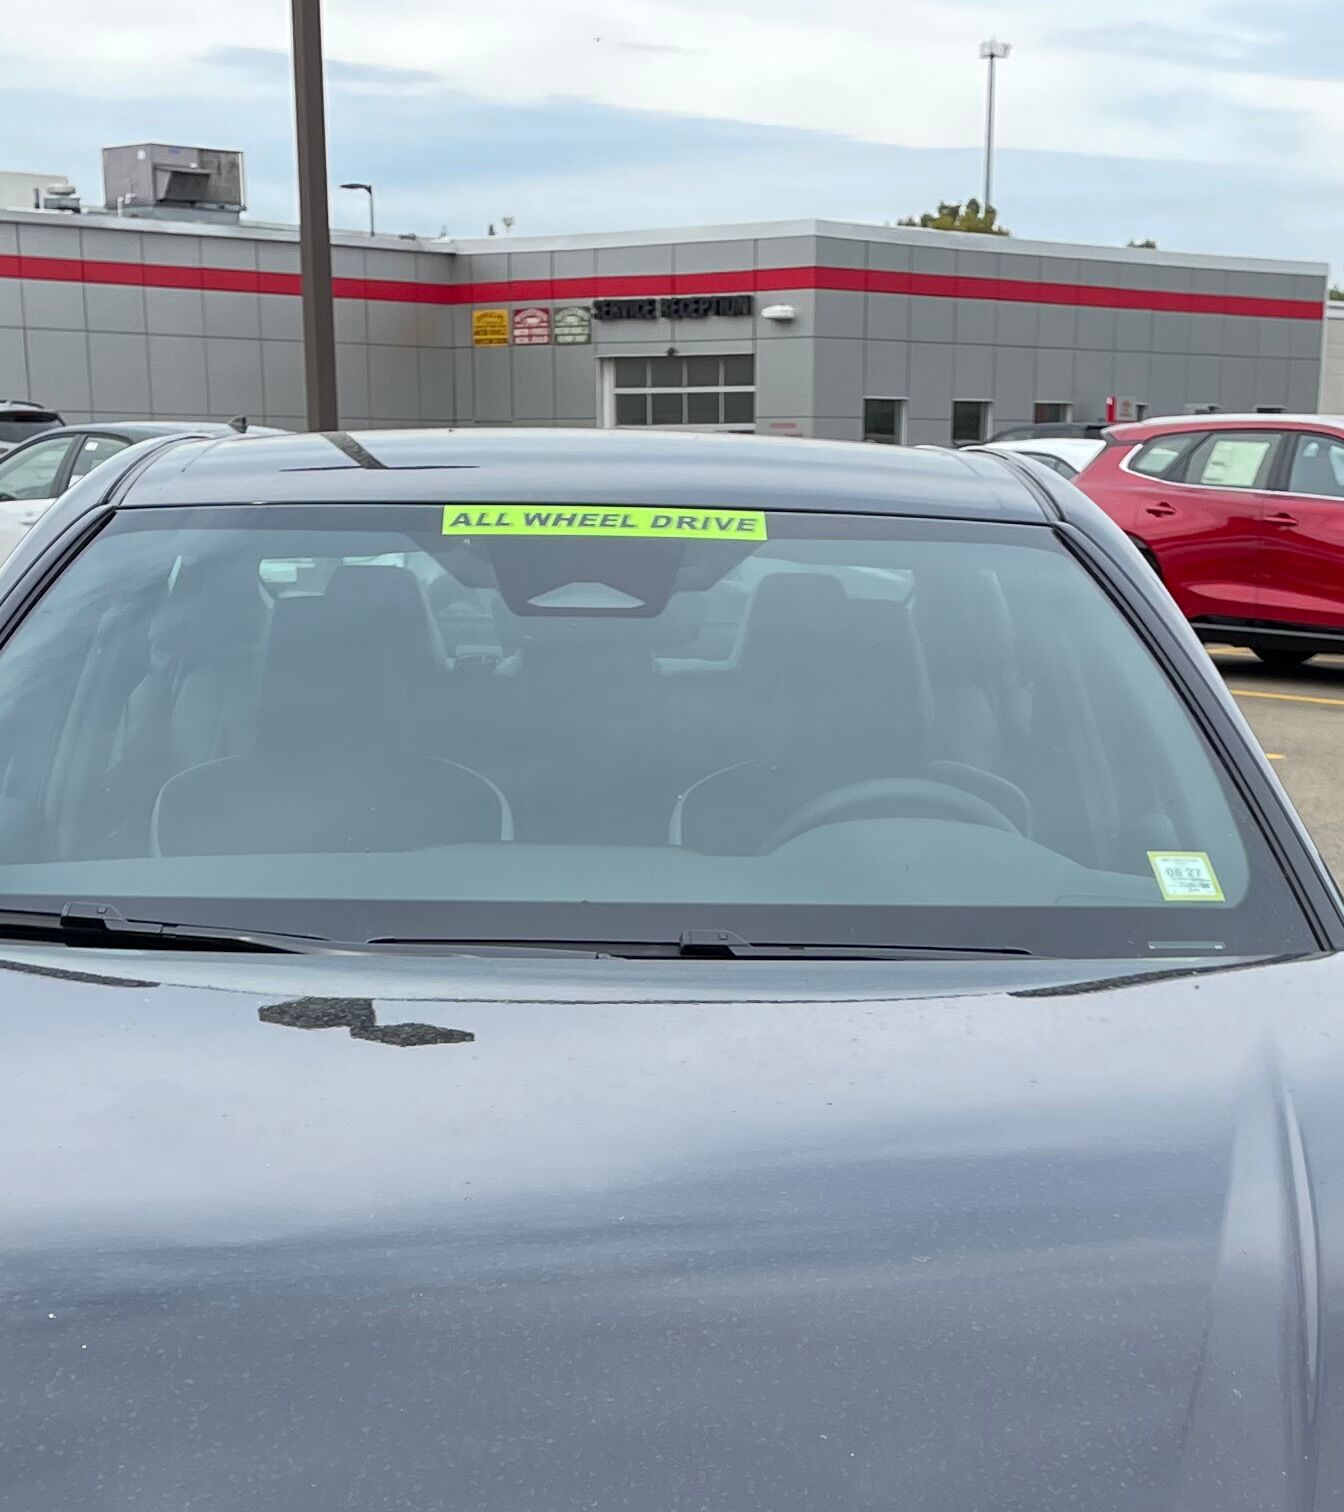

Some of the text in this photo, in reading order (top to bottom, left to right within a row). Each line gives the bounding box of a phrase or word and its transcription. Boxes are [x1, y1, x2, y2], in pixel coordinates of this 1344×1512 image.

[449, 511, 759, 532] ALL WHEEL DRIVE
